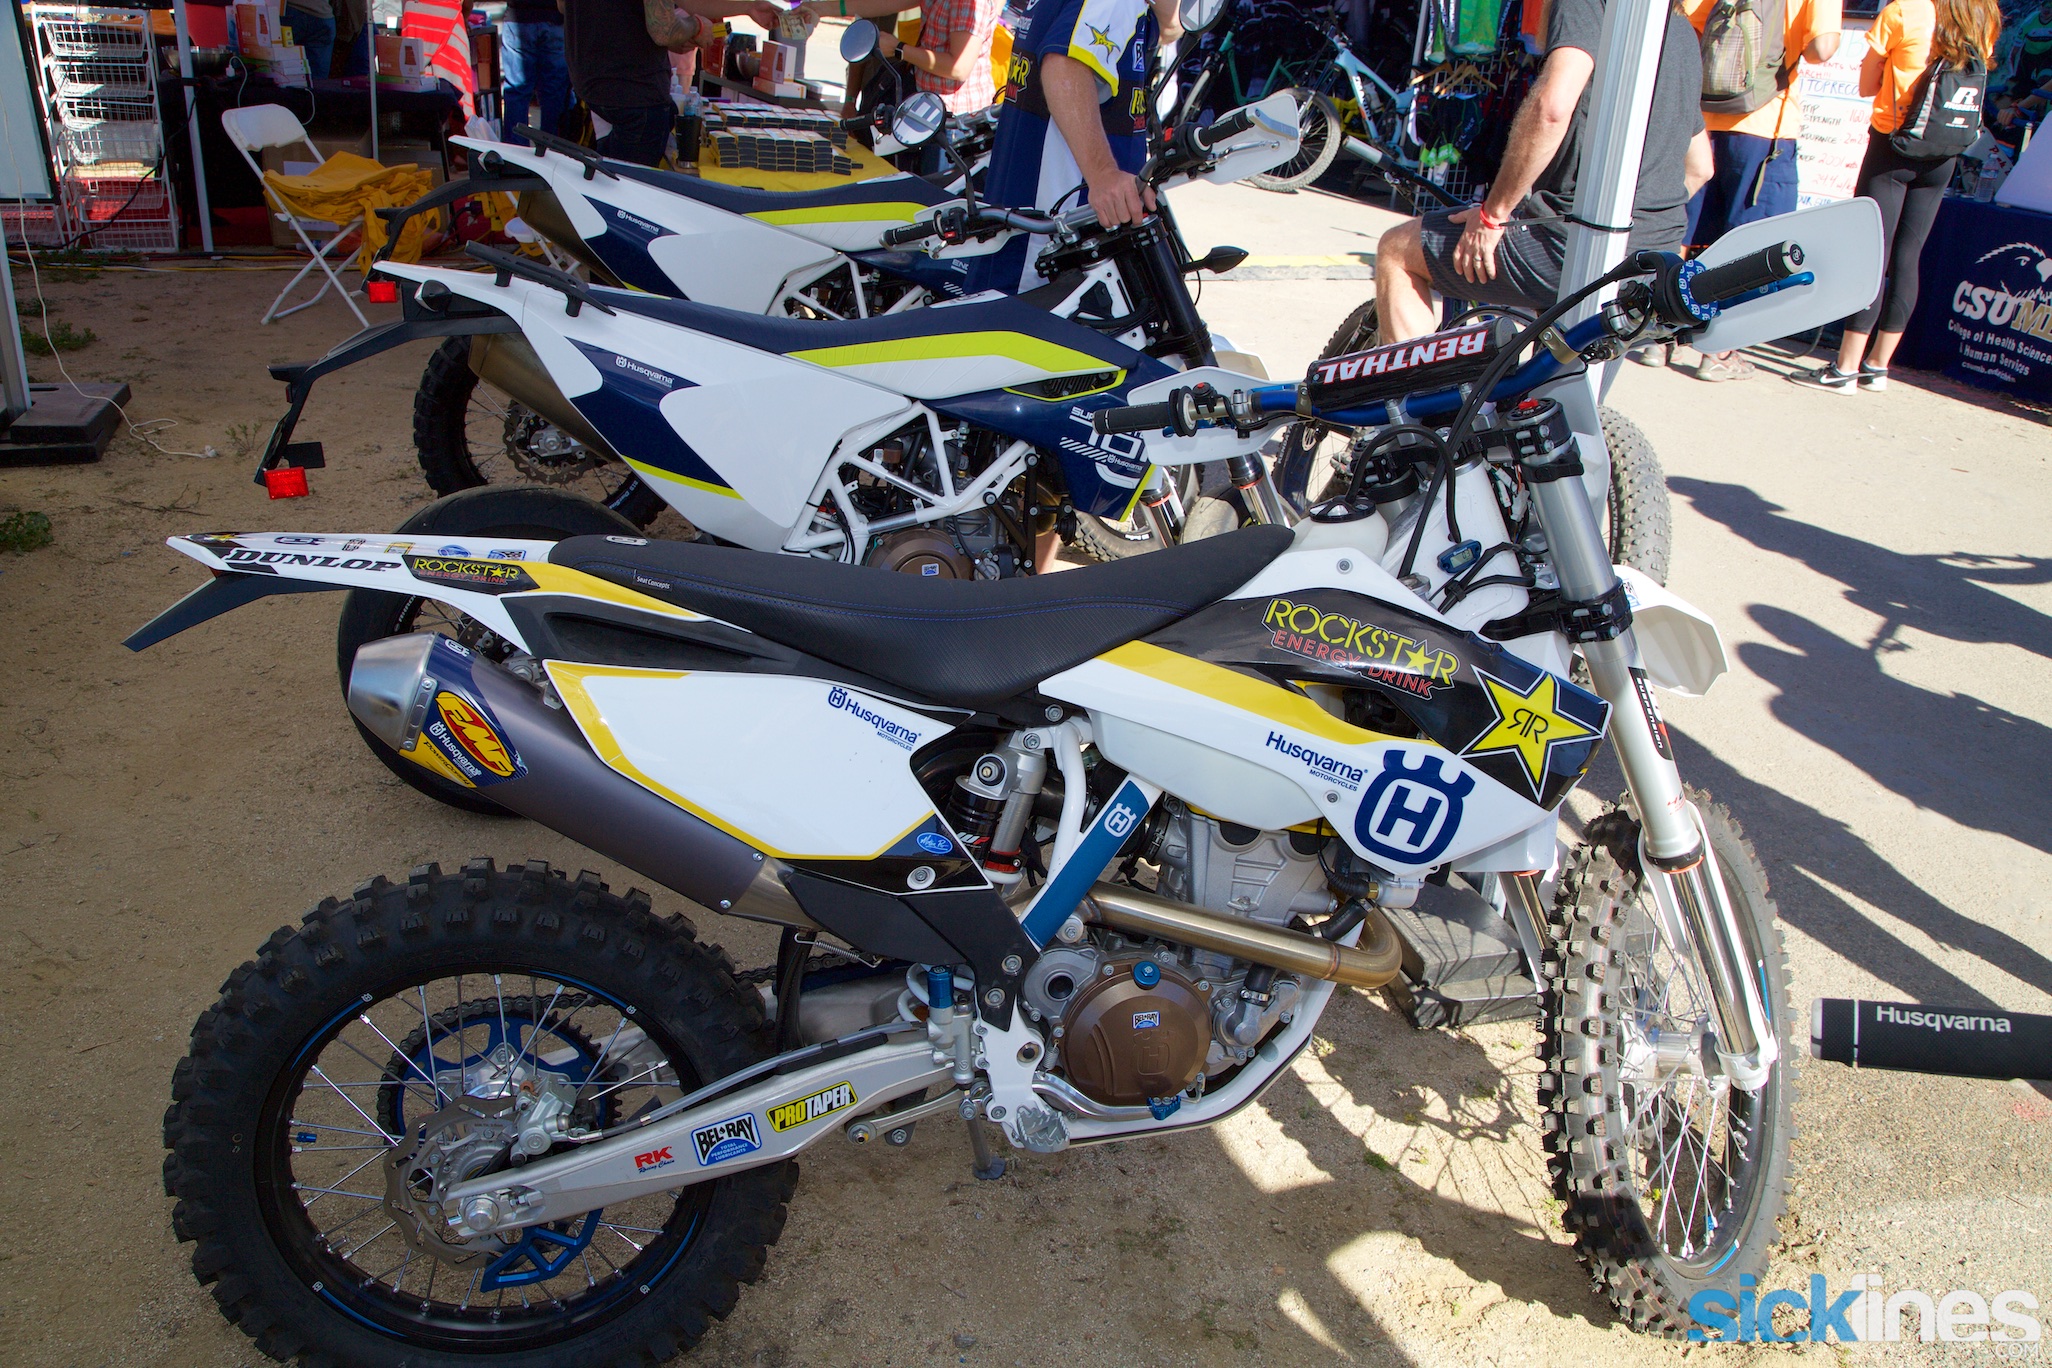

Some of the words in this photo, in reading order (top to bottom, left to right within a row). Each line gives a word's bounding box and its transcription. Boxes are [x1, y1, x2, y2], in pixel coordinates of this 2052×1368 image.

[1799, 132, 1837, 144] NDURANCE
[1317, 329, 1488, 385] RENTHAL
[1986, 332, 2015, 352] Health
[2017, 341, 2052, 365] Science
[626, 361, 674, 384] Husqvarna
[224, 549, 402, 573] DUNLOP
[471, 574, 507, 585] DRINK
[637, 576, 648, 584] Seat
[648, 578, 670, 589] Concepts
[1272, 630, 1361, 670] ENERGY
[1368, 662, 1433, 697] DRINK
[434, 696, 516, 772] FMF
[844, 697, 919, 745] Husqvarna
[437, 732, 479, 776] Husqvarna
[877, 731, 912, 752] MOTORCYCLES
[1265, 731, 1364, 783] Husqvarna
[1309, 769, 1359, 792] MOTORCYCLES
[1876, 1005, 2012, 1033] Husqvarna
[634, 1147, 673, 1169] RK
